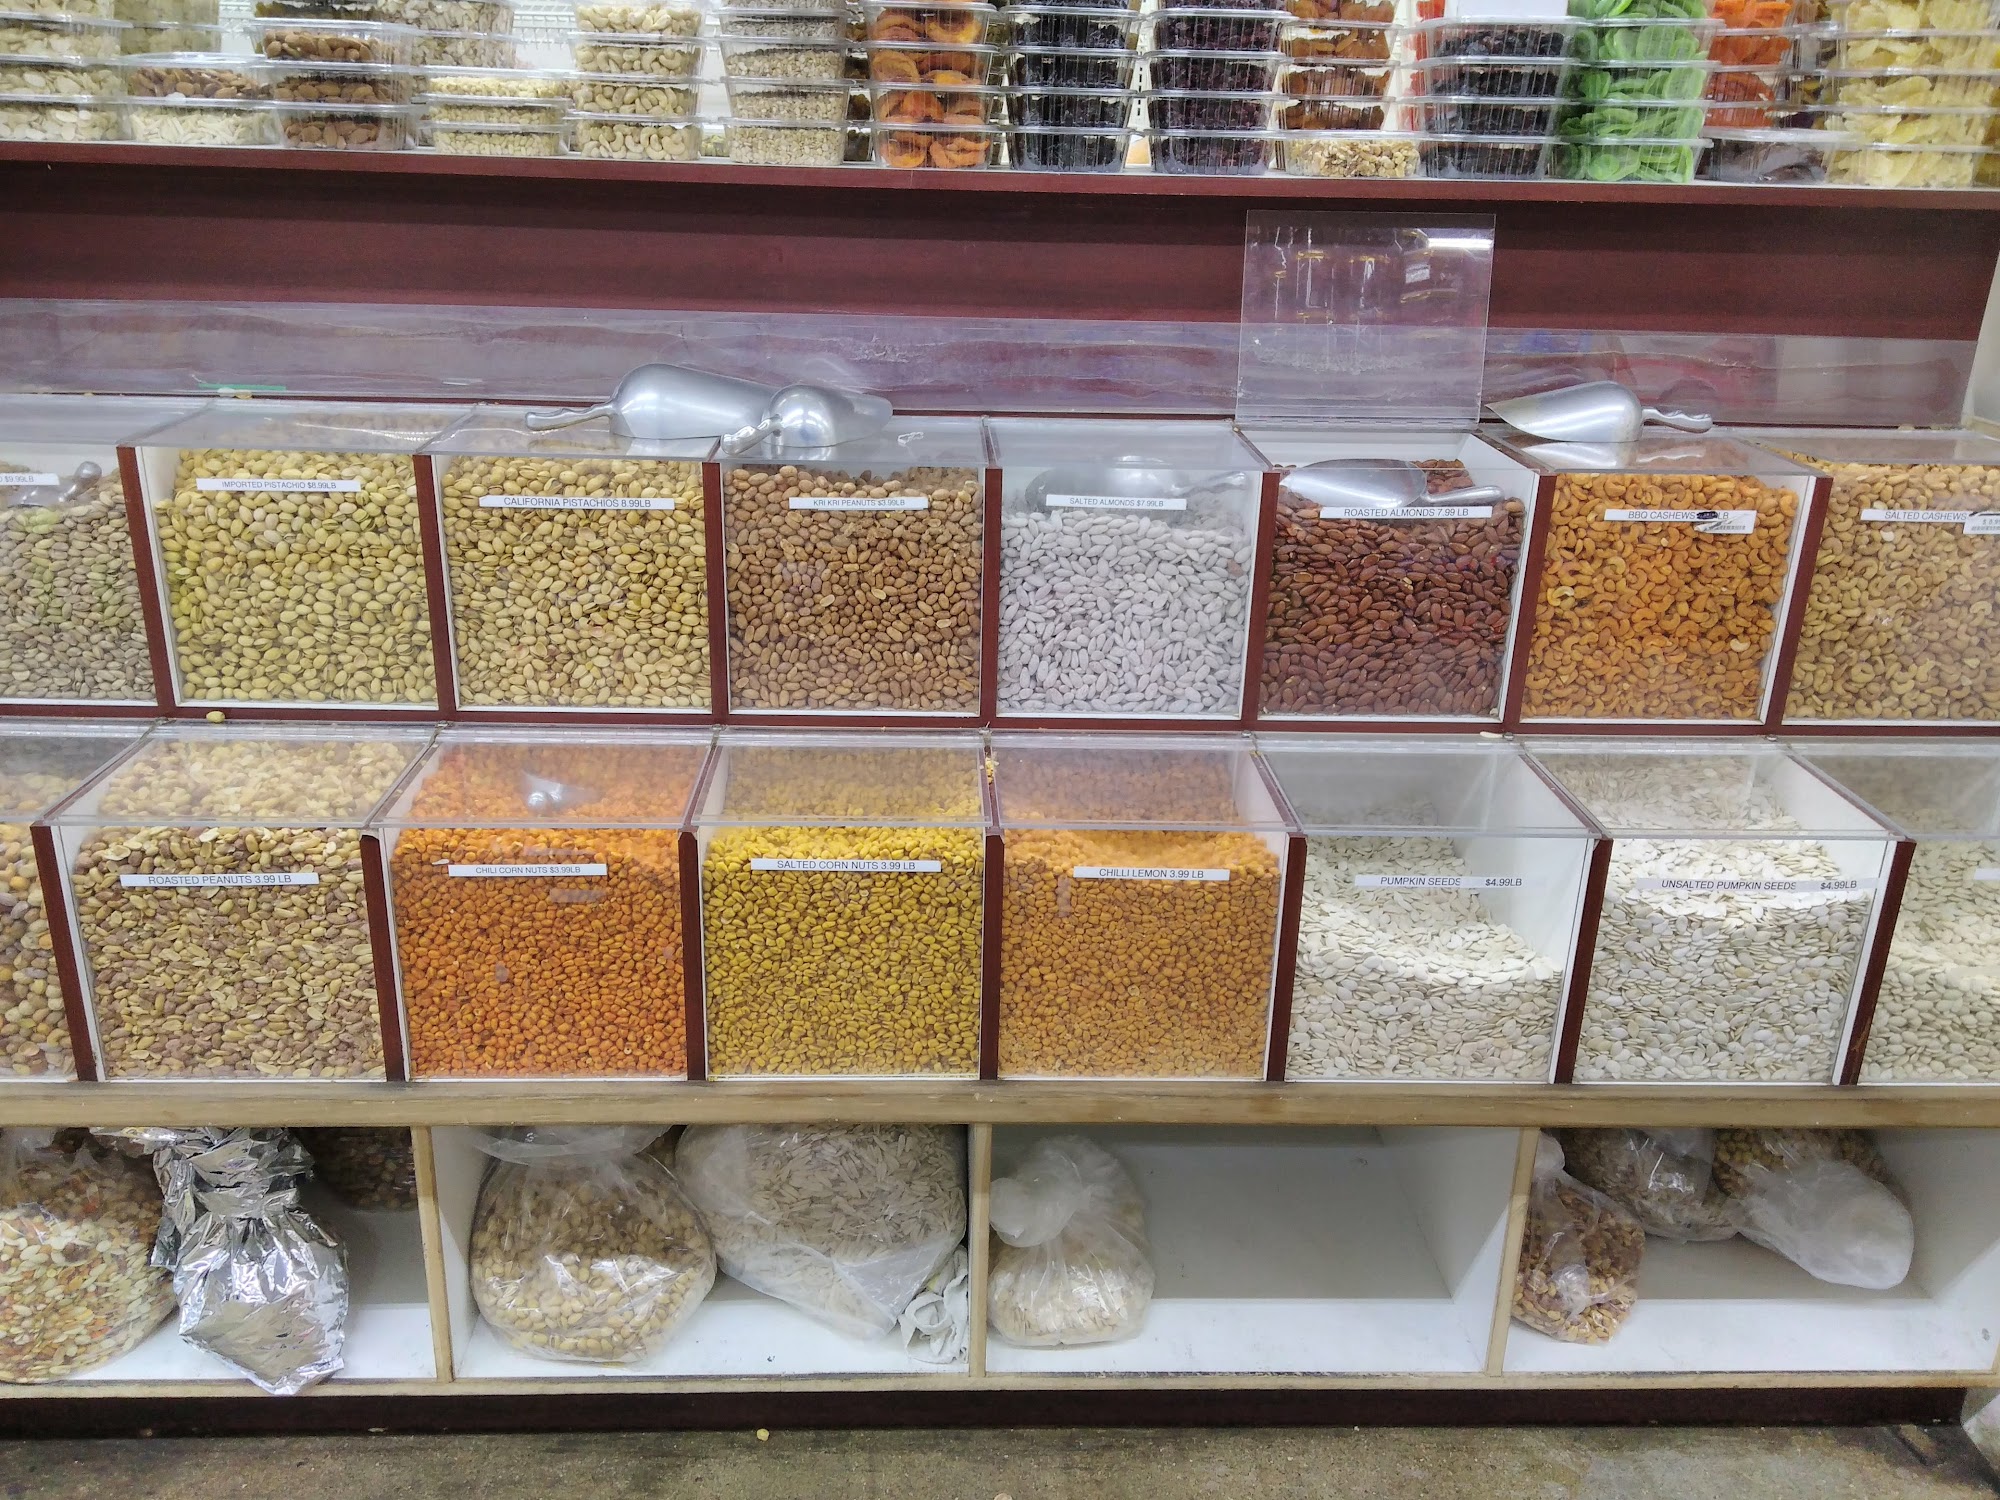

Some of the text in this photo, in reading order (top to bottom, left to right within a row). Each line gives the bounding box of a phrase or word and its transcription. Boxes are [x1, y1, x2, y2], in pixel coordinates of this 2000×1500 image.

[222, 481, 262, 489] IMPORTED
[264, 481, 305, 489] PISTACHIO
[503, 497, 651, 508] CALIFORNIA PISTACHIOS 8.99LB
[813, 499, 905, 507] KRI KRI PEANUTS $3.99LB
[1069, 498, 1098, 506] SALTED
[1100, 498, 1135, 507] ALMONDS
[1344, 508, 1469, 517] ROASTED ALMONDS 7.99 LB
[1628, 511, 1648, 520] BBQ
[1650, 511, 1696, 520] CASHEWS
[1884, 511, 1967, 521] SALTED CASHEWS
[777, 860, 916, 870] SALTED CORN NUTS 3.99 LB
[475, 866, 581, 875] CHILI CORN NUTS $3.99LB
[1099, 868, 1204, 879] CHILLI LEMON 3.99 LB
[148, 875, 292, 885] ROASTED PEANUTS 3.99 LB
[1380, 877, 1522, 887] PUMPKIN SEEDS $4.99LB
[1661, 880, 1857, 891] UNSALTED PUMPKIN SEEDS $4.99LB
